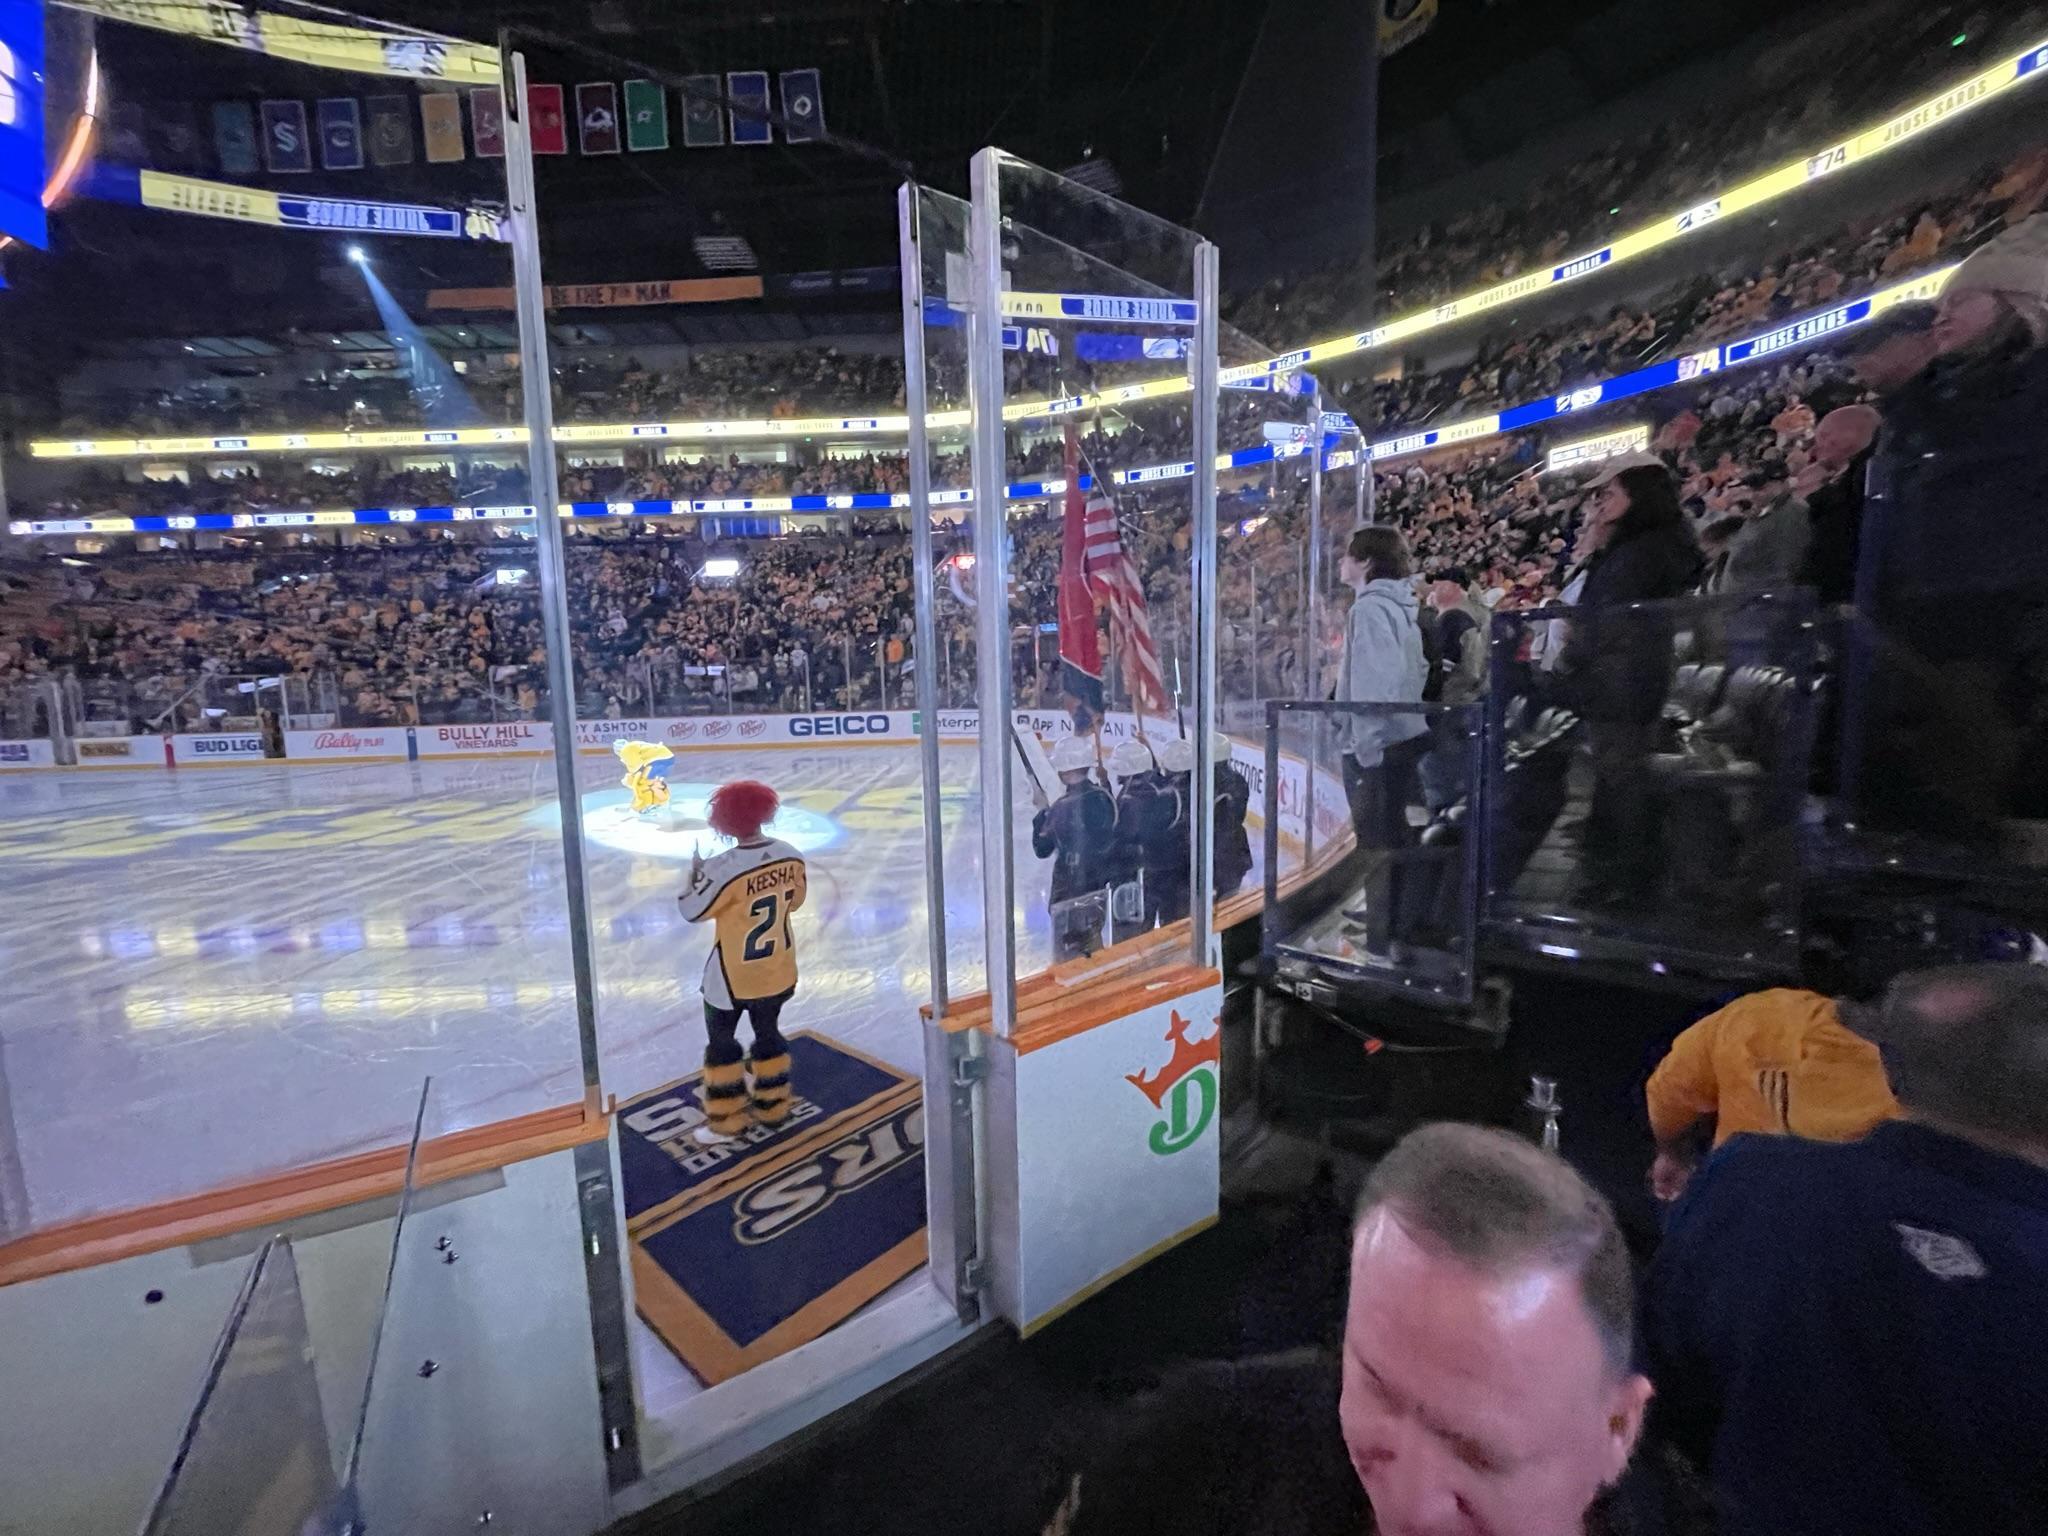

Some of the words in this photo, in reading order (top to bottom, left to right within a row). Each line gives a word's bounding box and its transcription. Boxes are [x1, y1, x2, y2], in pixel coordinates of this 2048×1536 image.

[1824, 146, 1846, 171] 74
[1696, 348, 1720, 374] 74
[1797, 309, 1848, 340] SAROS
[438, 727, 490, 741] BULLY
[495, 725, 534, 739] HILL
[593, 721, 648, 733] ASHTON
[789, 714, 890, 736] GEICO
[194, 740, 229, 752] BUD
[745, 864, 795, 897] KEESHA
